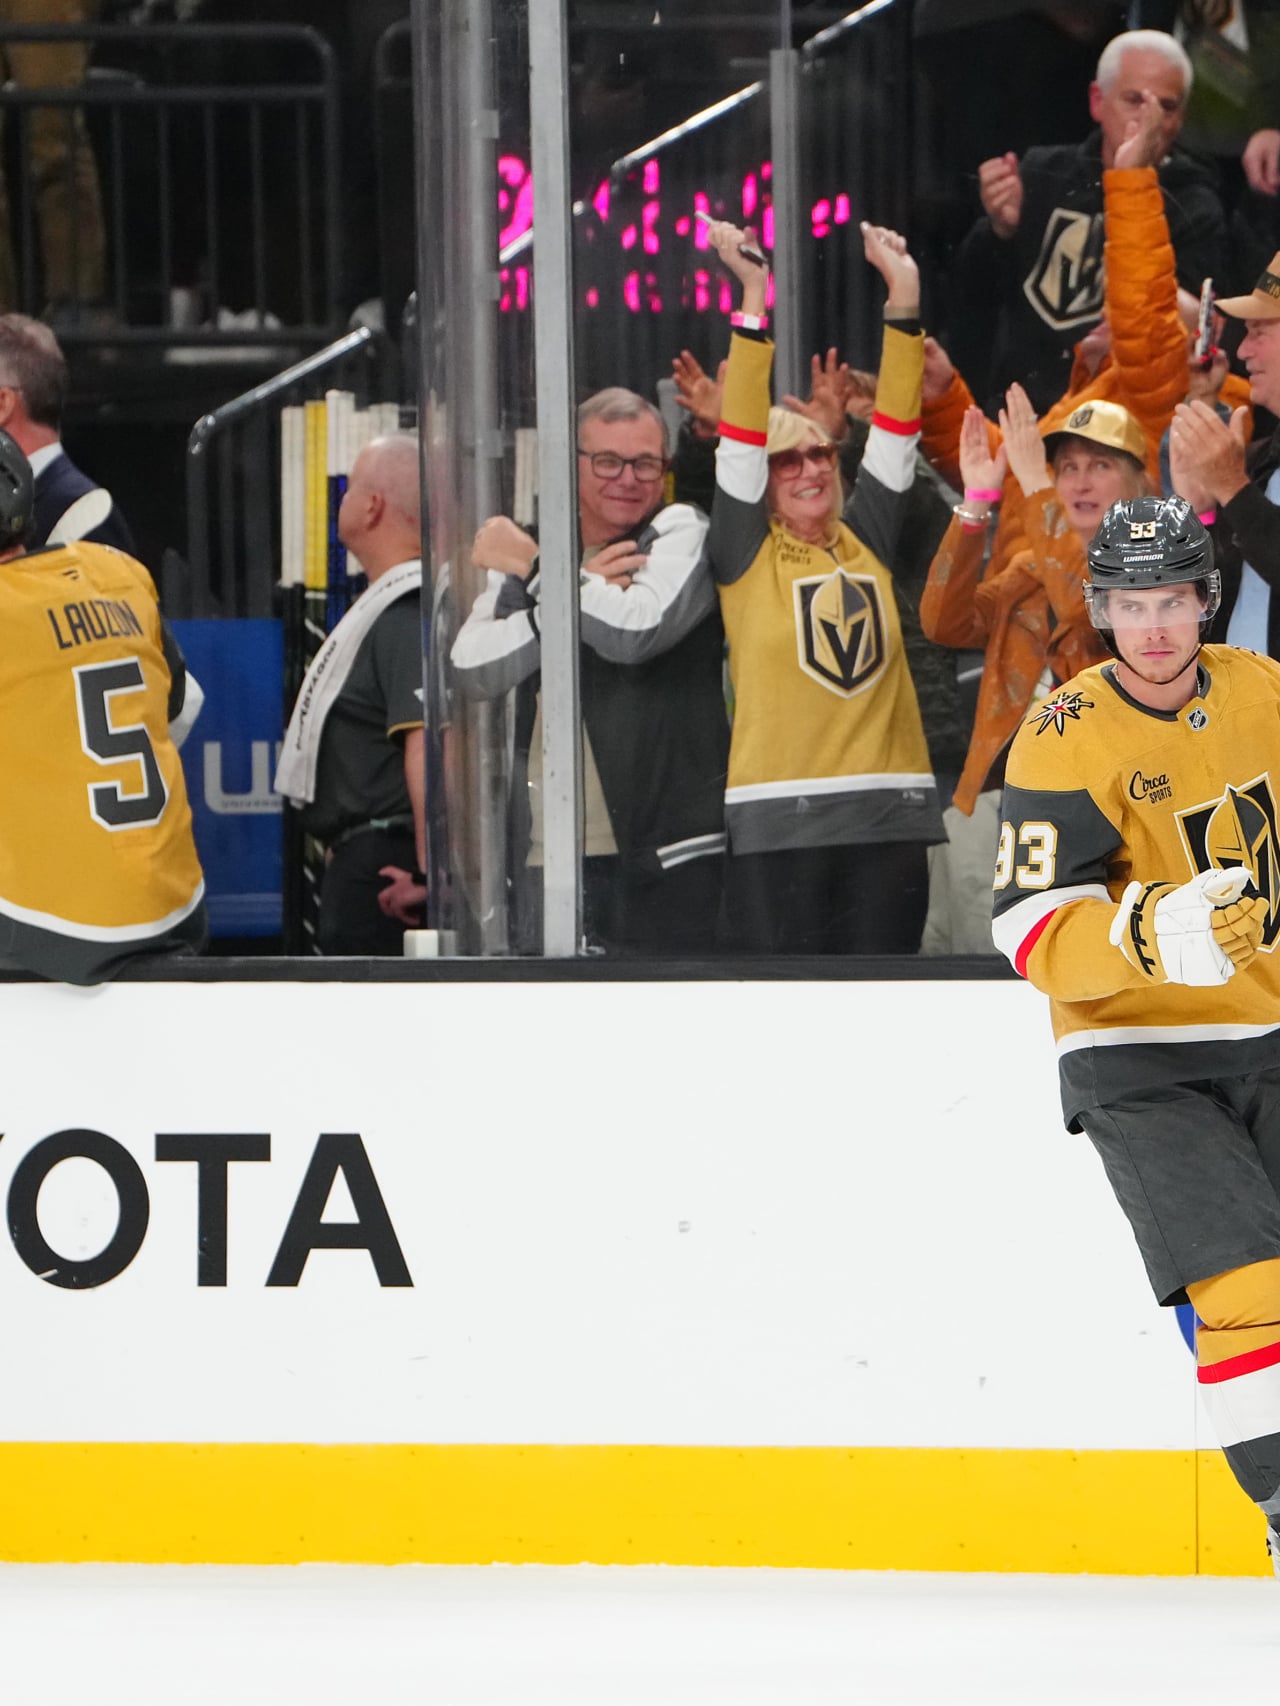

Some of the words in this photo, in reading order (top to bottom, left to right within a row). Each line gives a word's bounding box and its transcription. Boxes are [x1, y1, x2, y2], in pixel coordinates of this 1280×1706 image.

[1129, 521, 1157, 540] 93
[1123, 553, 1164, 563] WARRIOR
[47, 597, 144, 650] LAUZON
[71, 655, 170, 832] 5
[1129, 770, 1170, 801] Circa
[1149, 786, 1172, 804] SPORTS
[992, 820, 1058, 890] 93
[0, 1127, 415, 1290] OTA
